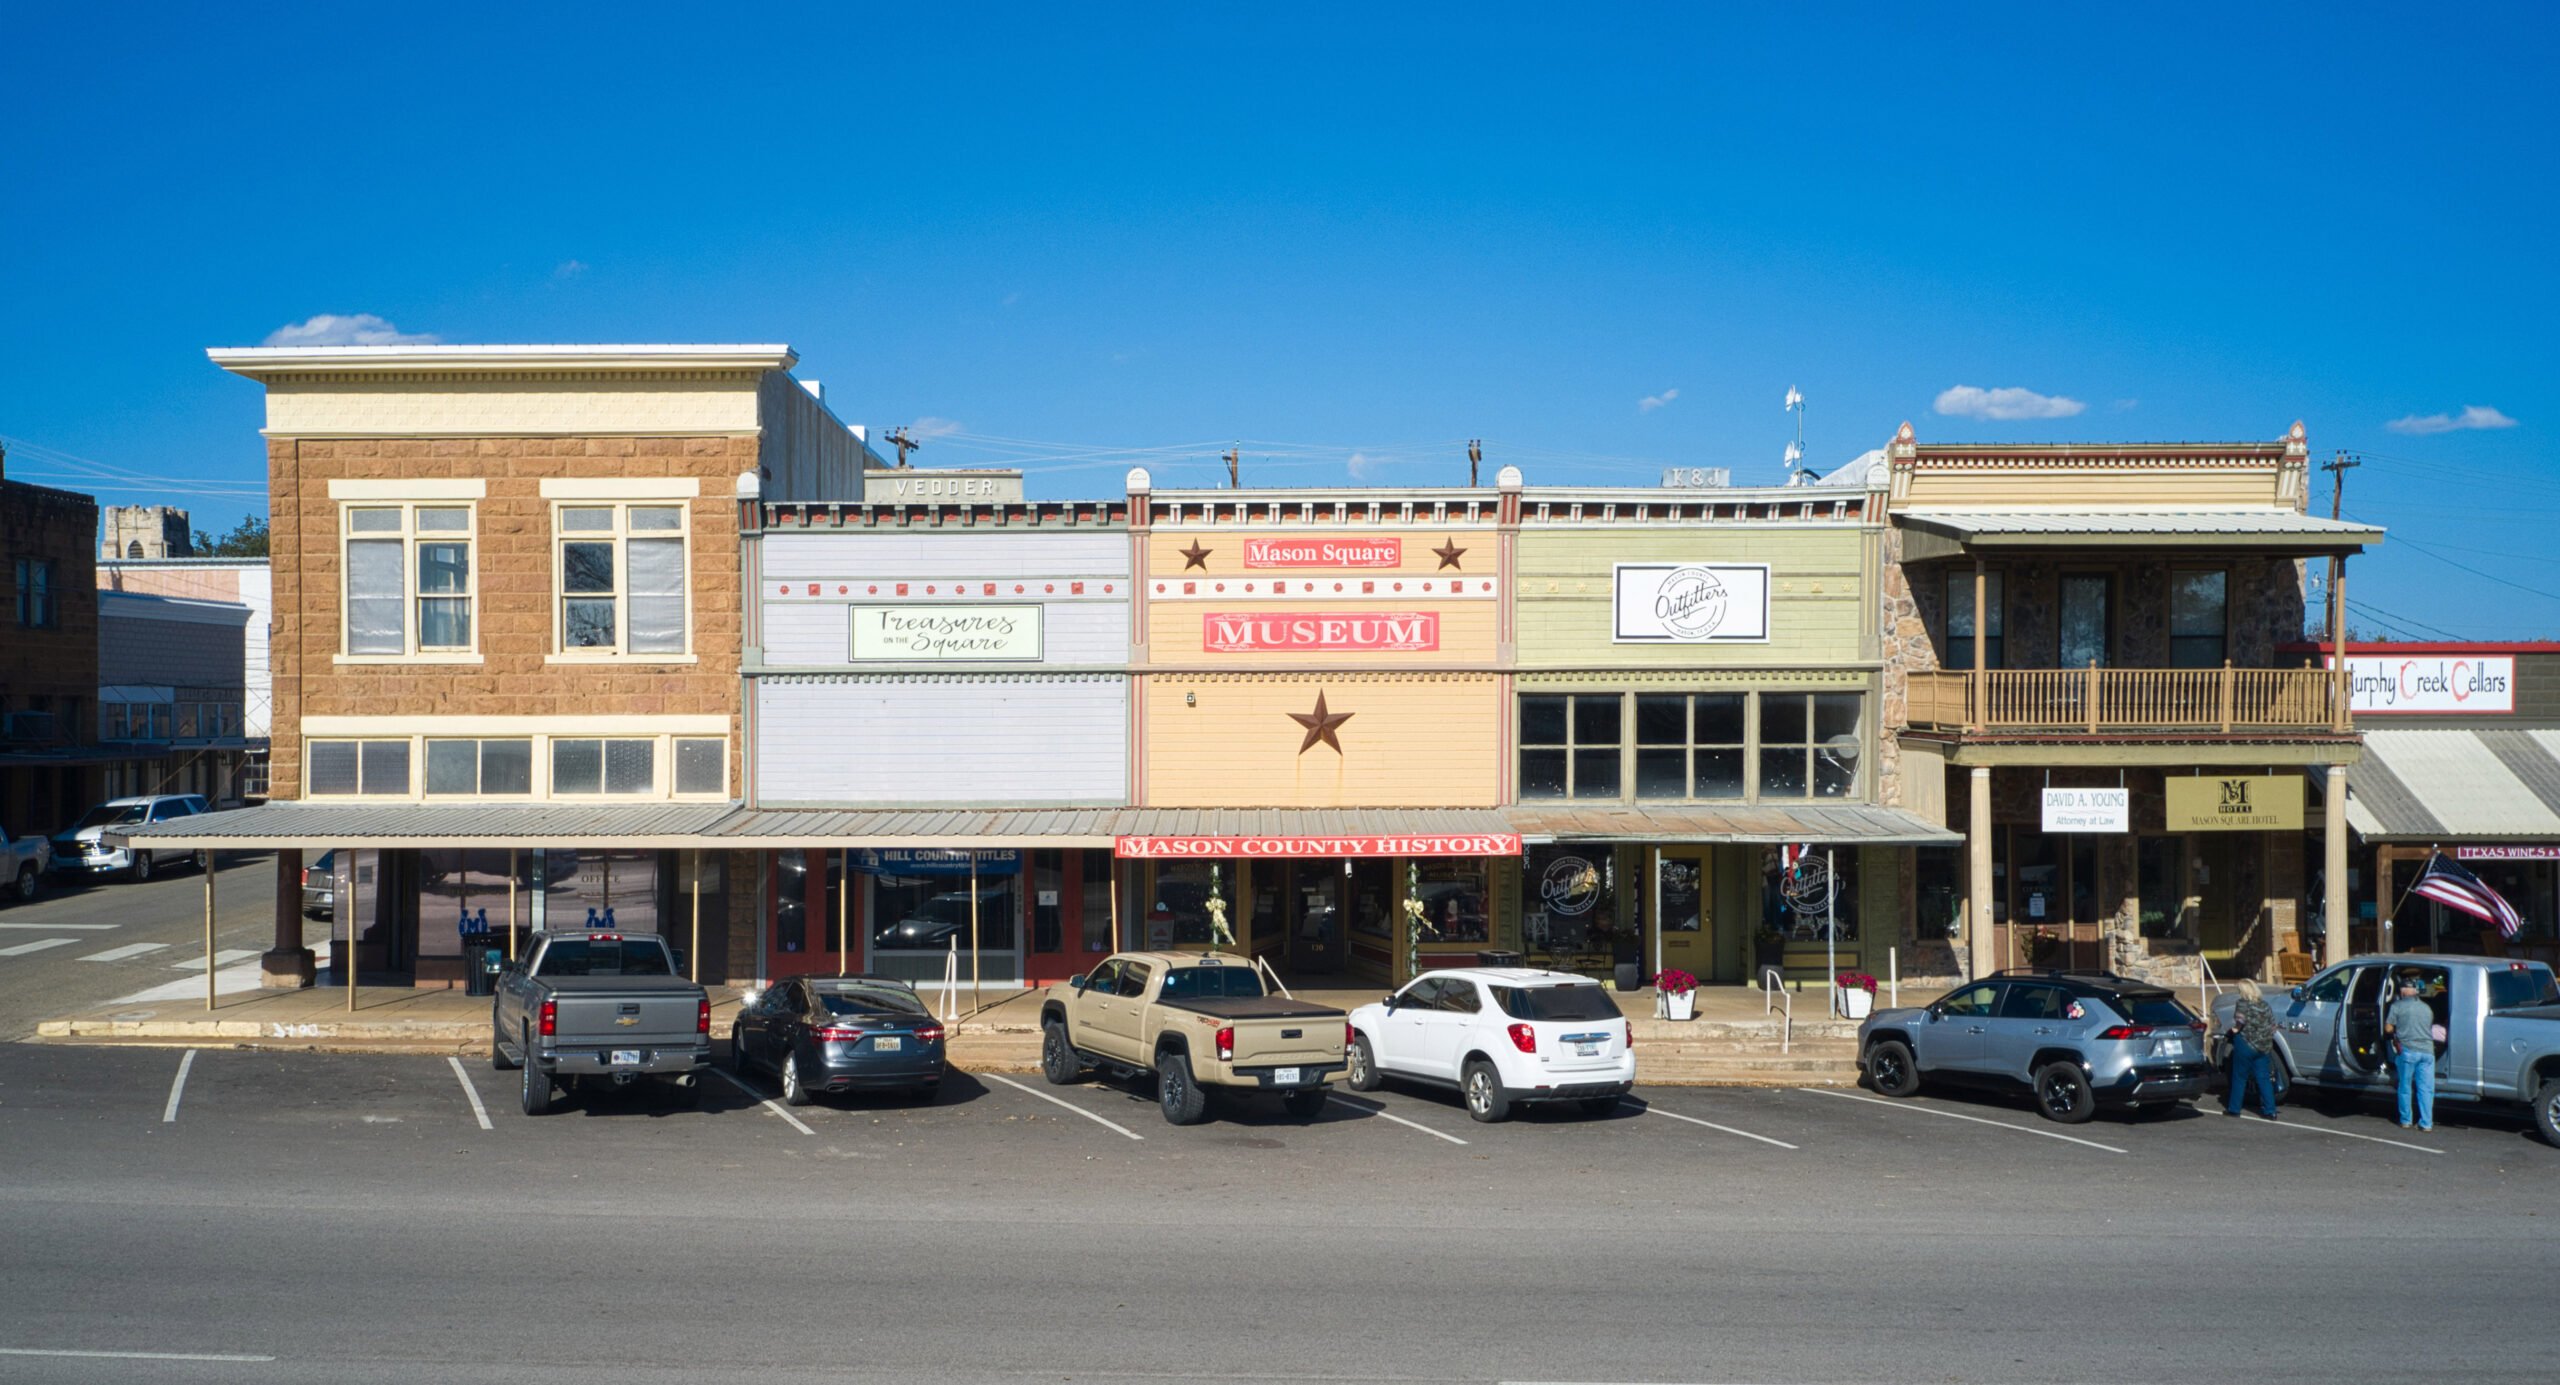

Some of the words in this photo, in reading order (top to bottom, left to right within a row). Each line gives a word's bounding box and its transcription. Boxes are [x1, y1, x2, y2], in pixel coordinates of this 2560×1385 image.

[896, 479, 993, 496] VEDDER
[1250, 544, 1317, 561] Mason
[1323, 543, 1395, 565] Square
[1656, 582, 1728, 619] Outfitters
[877, 610, 1017, 634] Treasures
[1214, 620, 1424, 644] MUSEUM
[911, 632, 1007, 657] Square
[2350, 661, 2396, 707] urphy
[2400, 660, 2448, 700] Creek
[2452, 660, 2505, 702] Cellars
[2047, 793, 2074, 807] DAVID
[2078, 793, 2087, 807] A.
[2091, 793, 2124, 807] YOUNG
[2056, 816, 2086, 827] Attorney
[2089, 816, 2096, 825] at
[2099, 816, 2115, 825] Law
[2192, 815, 2219, 825] MASON
[2220, 815, 2250, 826] SQUARE
[2252, 815, 2279, 825] HOTEL
[884, 850, 911, 861] HILL
[915, 850, 971, 861] COUNTRY
[976, 850, 1016, 861] TITLES
[1125, 839, 1234, 855] MASON
[1242, 839, 1368, 854] COUNTY
[1376, 837, 1514, 854] HISTORY
[2463, 847, 2505, 857] TEXAS
[2508, 847, 2546, 857] WINES
[1781, 868, 1840, 897] Outfittes
